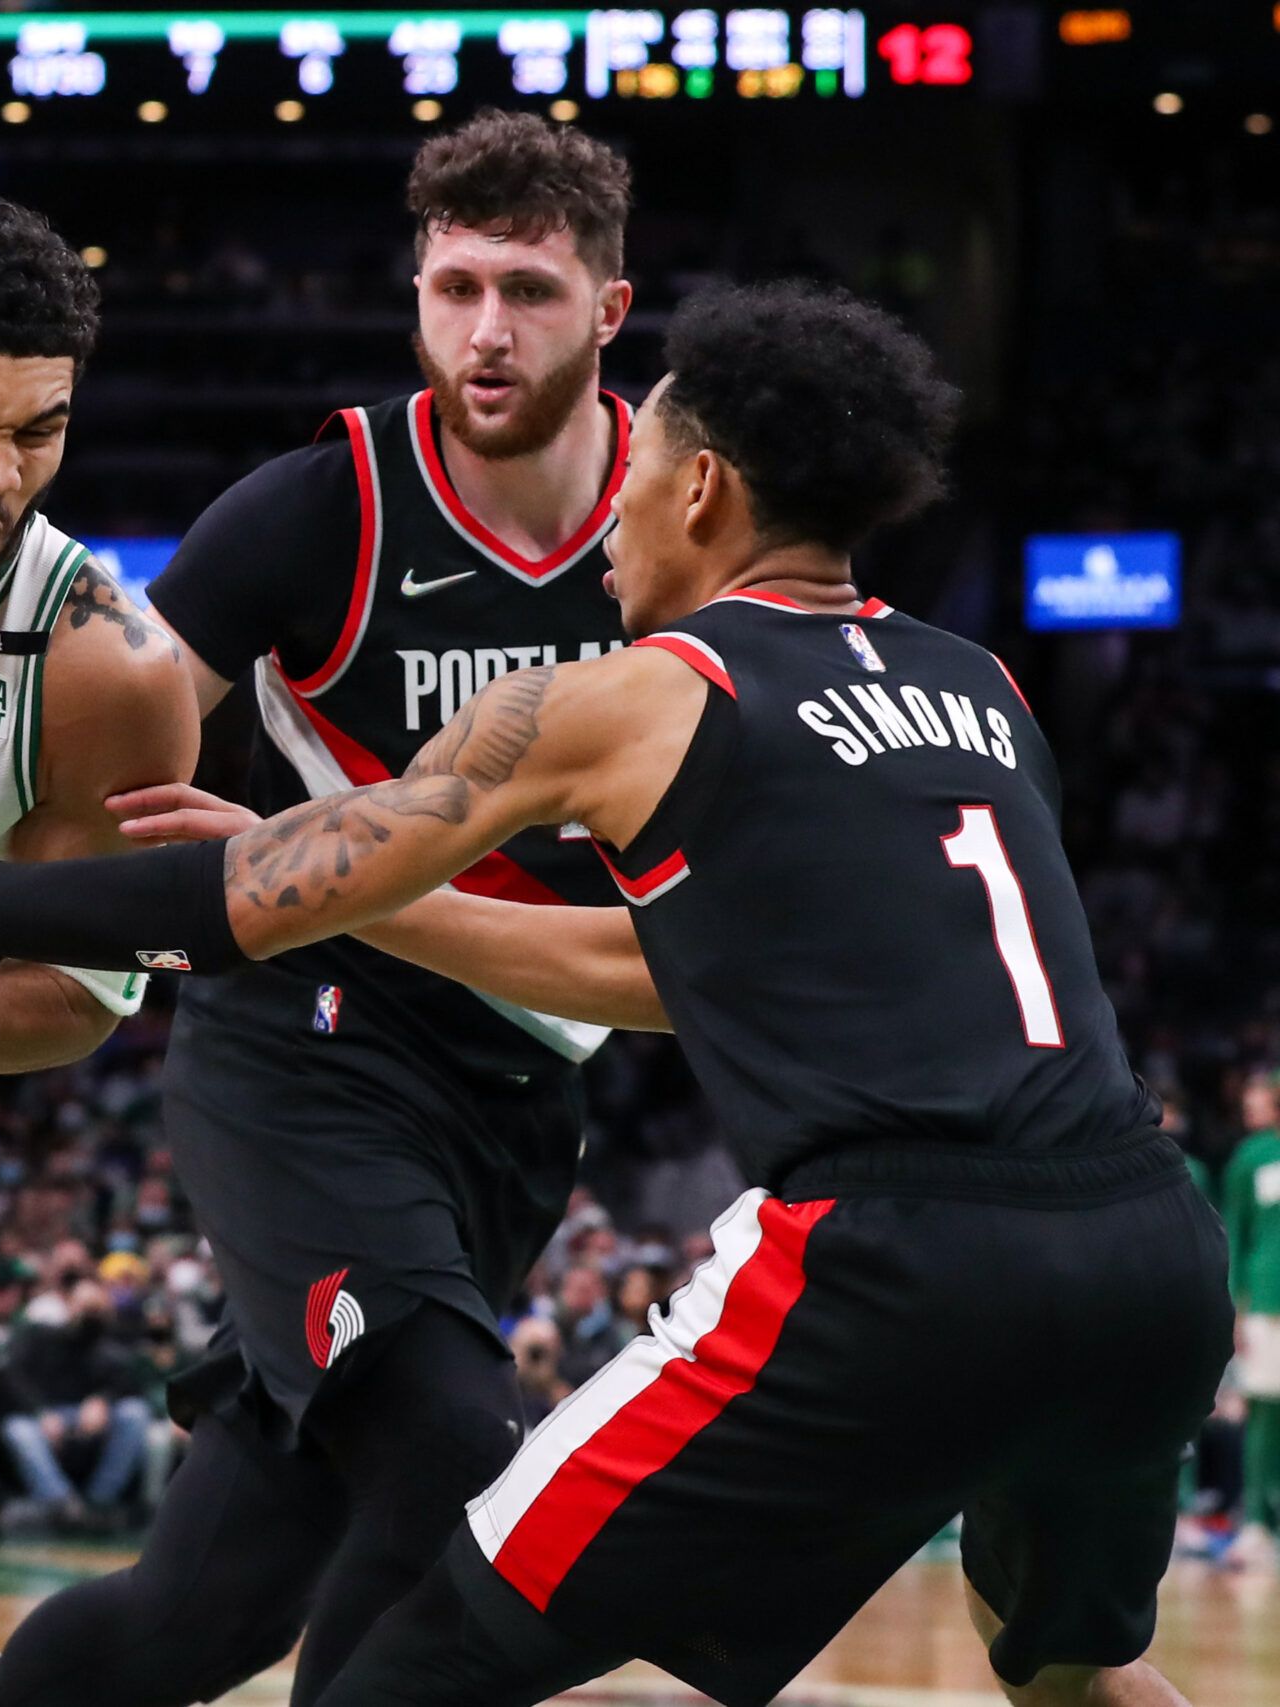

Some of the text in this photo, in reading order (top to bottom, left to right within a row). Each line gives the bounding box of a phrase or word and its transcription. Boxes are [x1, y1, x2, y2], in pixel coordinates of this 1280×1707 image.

[880, 24, 972, 84] 12
[797, 683, 1017, 770] SIMONS
[939, 804, 1066, 1048] 1
